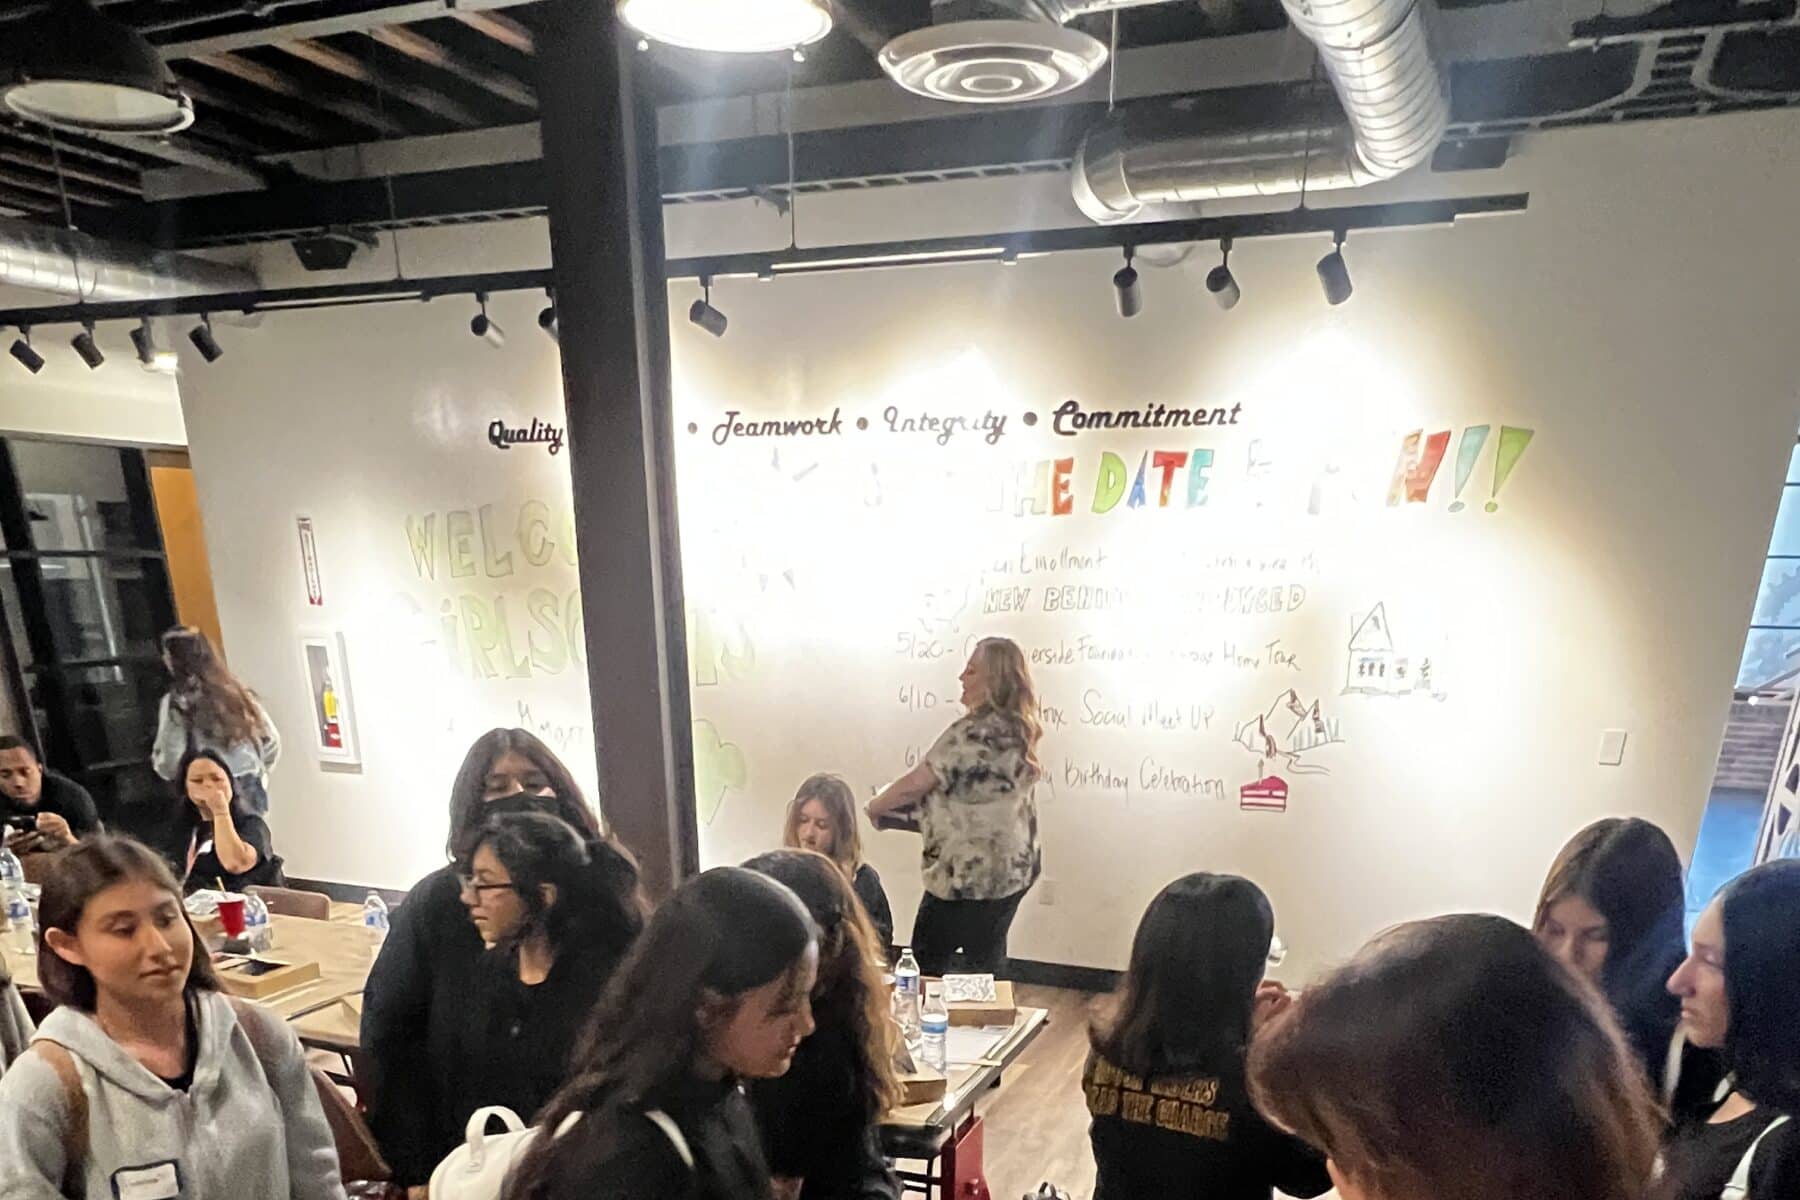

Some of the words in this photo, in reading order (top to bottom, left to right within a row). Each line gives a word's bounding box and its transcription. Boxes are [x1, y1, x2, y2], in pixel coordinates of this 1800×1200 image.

[487, 418, 565, 455] Quality
[711, 407, 844, 446] Teamwork
[883, 406, 1008, 446] Integrity
[1053, 401, 1243, 436] Commitment
[1090, 447, 1216, 515] DATE
[982, 586, 1032, 615] NEW
[897, 684, 937, 712] 6/10
[1081, 688, 1132, 727] Social
[1065, 755, 1130, 803] Birthday
[1139, 754, 1226, 800] Celebration
